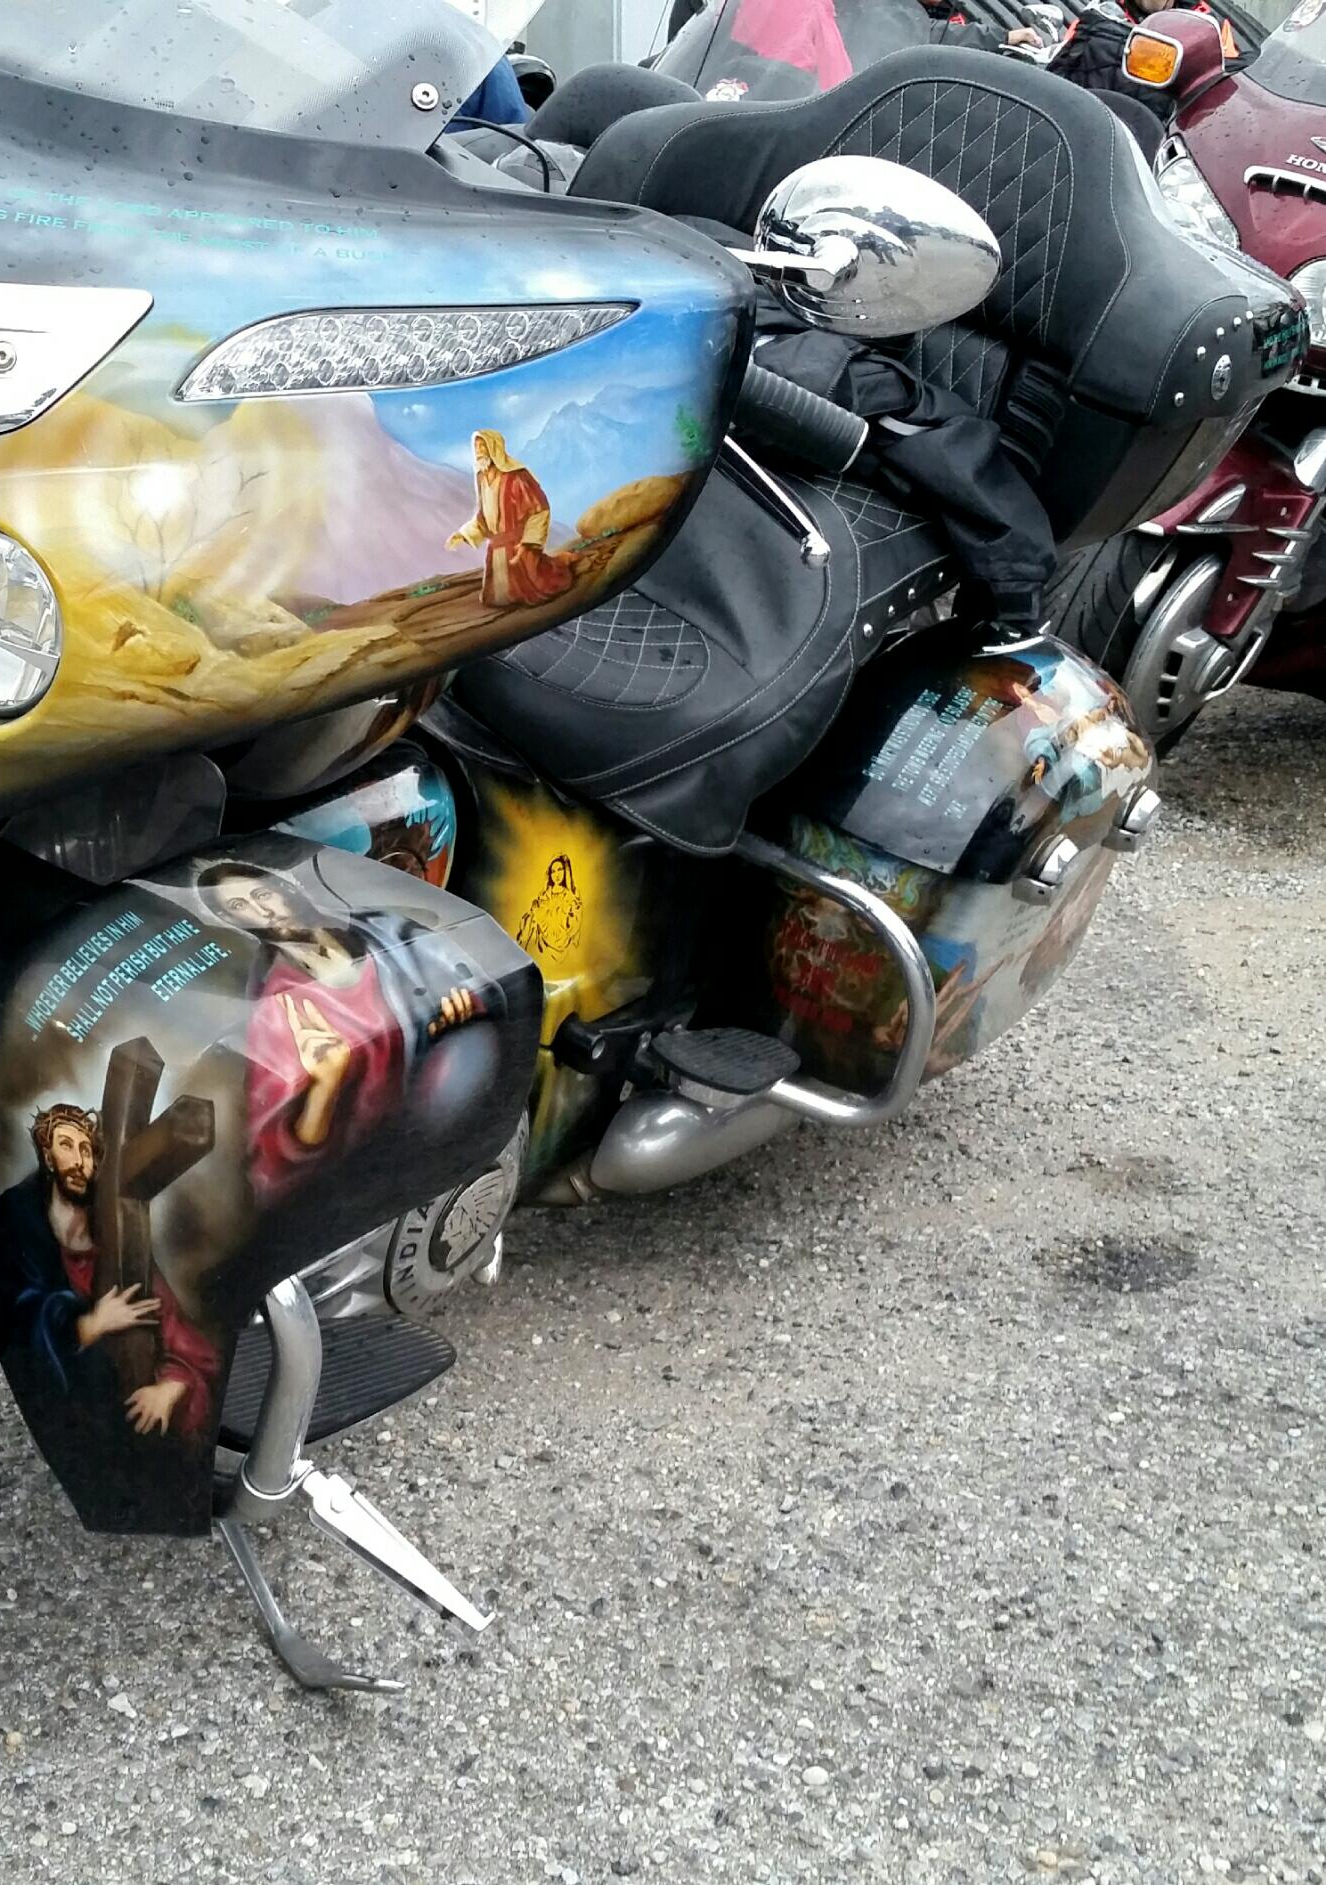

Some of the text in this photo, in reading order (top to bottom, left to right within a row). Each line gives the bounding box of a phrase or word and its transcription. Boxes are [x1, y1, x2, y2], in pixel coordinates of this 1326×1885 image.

[14, 212, 67, 229] FIRE
[45, 192, 89, 207] THE
[65, 931, 114, 984] BELIEVES
[103, 922, 125, 941] IN
[120, 911, 145, 932] HIM
[66, 919, 201, 1043] SHALL NOT PERISH BUT HAVE
[150, 952, 208, 1002] ETERNAL
